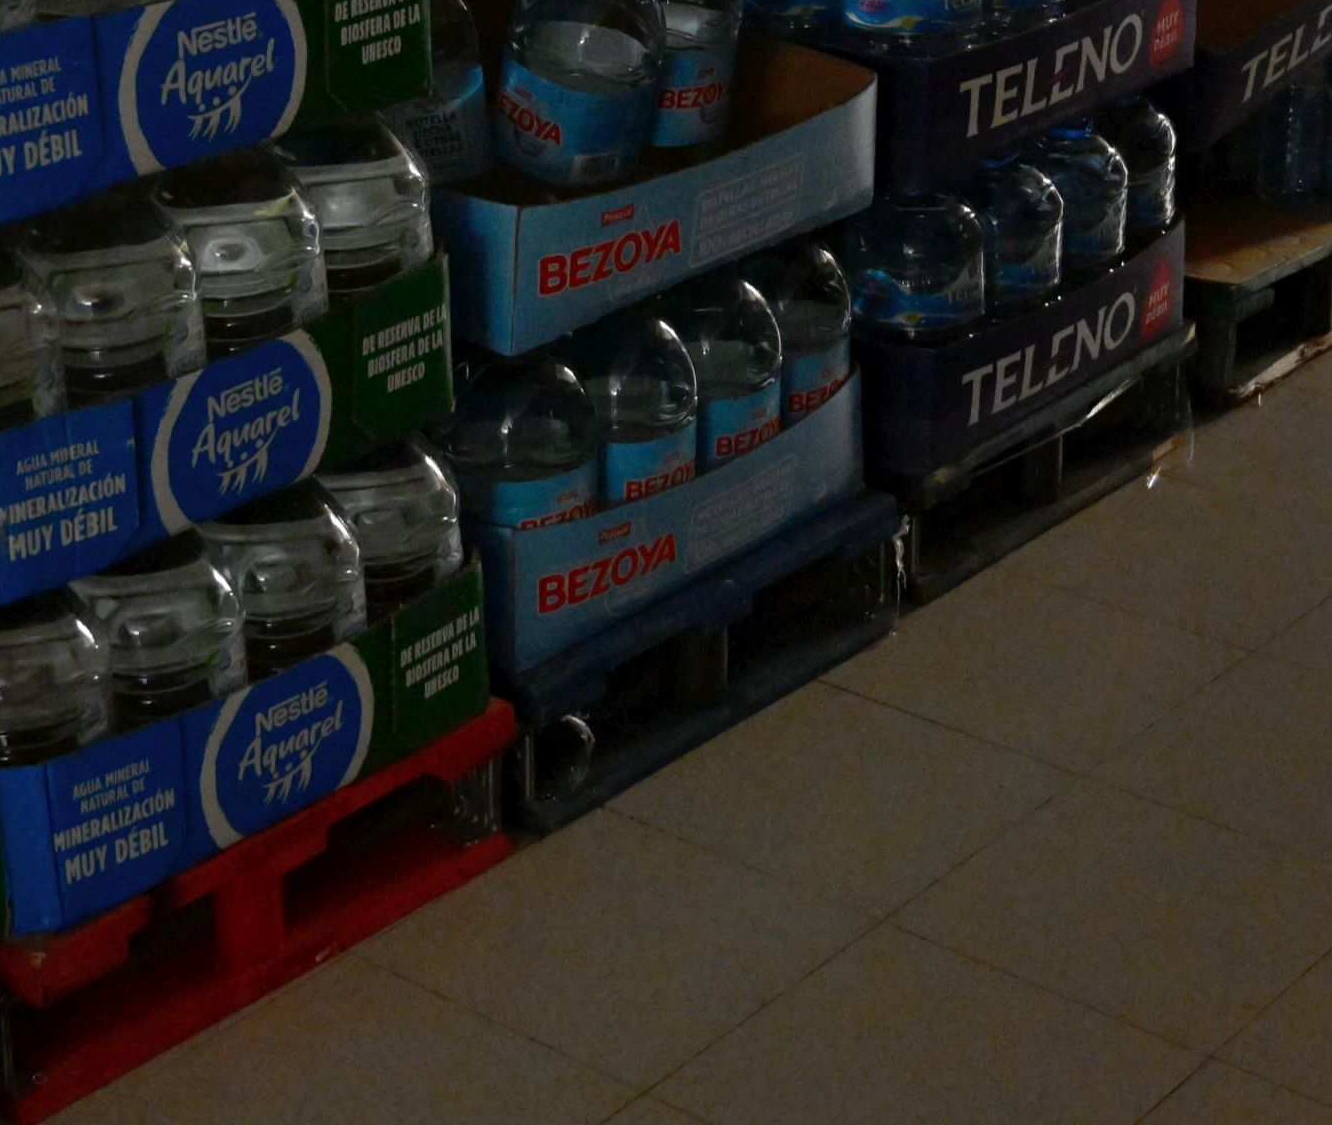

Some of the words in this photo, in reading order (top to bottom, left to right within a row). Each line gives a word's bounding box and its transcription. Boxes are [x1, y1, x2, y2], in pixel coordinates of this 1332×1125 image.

[1156, 9, 1180, 33] MUY
[10, 55, 62, 82] MINERAL
[361, 35, 403, 67] UNESCO
[40, 77, 57, 95] DE
[161, 38, 277, 107] Aquarel
[959, 12, 1145, 141] TELENO
[23, 129, 84, 171] DÉBIL
[539, 220, 682, 296] BEZOYA
[1148, 282, 1170, 308] MUY
[386, 364, 426, 395] UNESCO
[961, 290, 1137, 427] TELENO
[191, 388, 301, 469] Aquarel
[16, 452, 49, 476] AGUA
[50, 440, 101, 467] MINERAL
[25, 466, 75, 492] NATURAL
[78, 459, 94, 476] DE
[7, 522, 54, 563] MUY
[60, 506, 119, 548] DÉBIL
[537, 533, 677, 614] BEZOYA
[424, 666, 461, 701] UNESCO
[238, 699, 344, 781] Aquarel
[72, 778, 103, 801] AGUA
[104, 759, 152, 789] MINERAL
[80, 788, 129, 816] NATURAL
[131, 777, 148, 797] DE
[53, 787, 176, 854] MINERALIZACIÓN
[64, 843, 110, 886] MUY
[114, 821, 169, 867] DÉBIL
